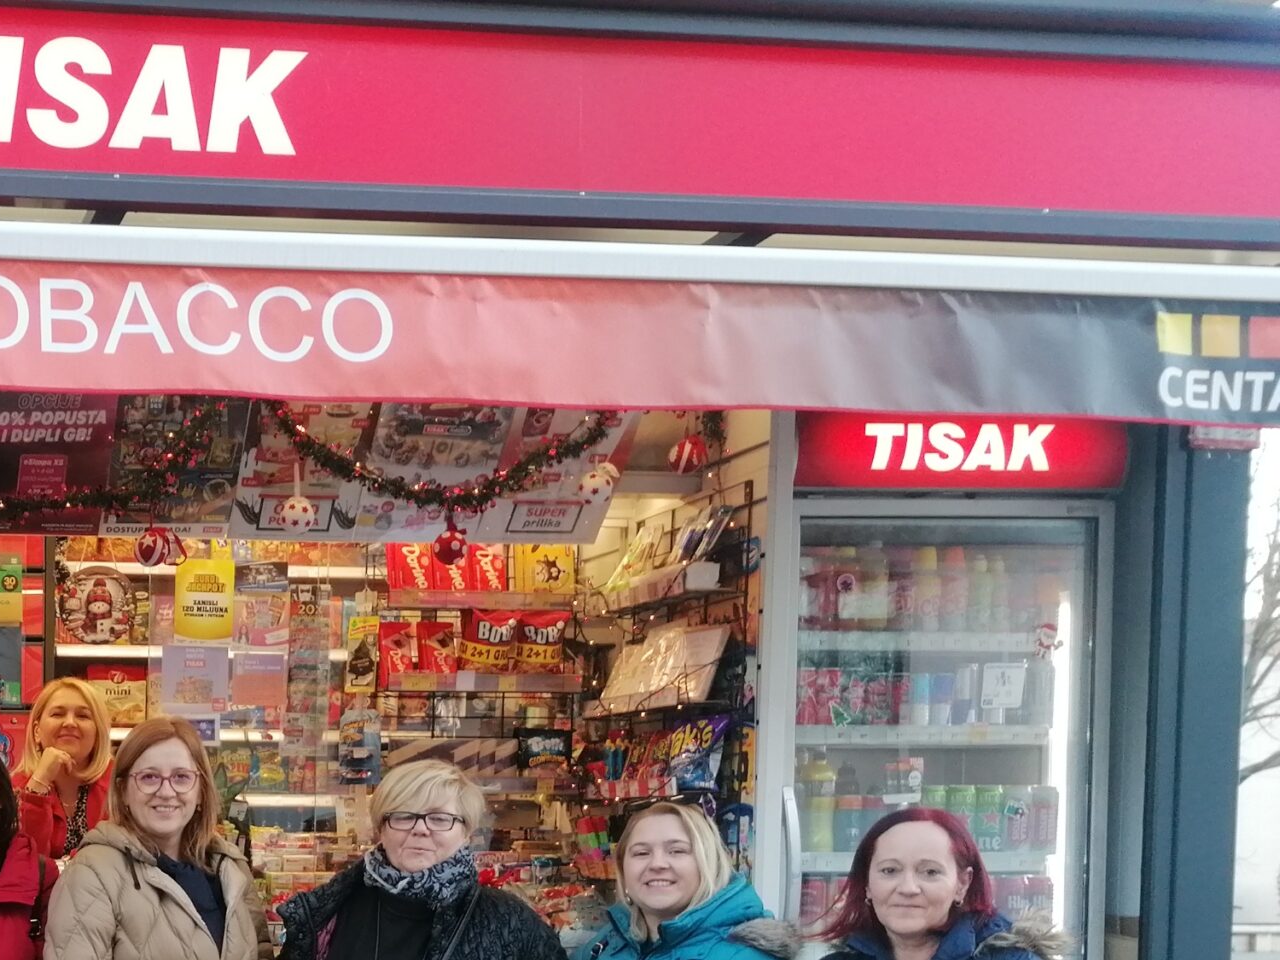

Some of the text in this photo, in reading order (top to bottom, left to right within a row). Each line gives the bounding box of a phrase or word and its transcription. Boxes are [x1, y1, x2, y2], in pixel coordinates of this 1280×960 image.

[18, 393, 82, 409] OPCIJE
[29, 410, 106, 426] POPUSTA
[10, 428, 61, 442] DUPLI
[63, 427, 93, 442] GB!
[866, 423, 1054, 471] TISAK
[526, 506, 568, 518] SUPER
[106, 526, 147, 534] DOSTUP
[105, 685, 131, 696] mini
